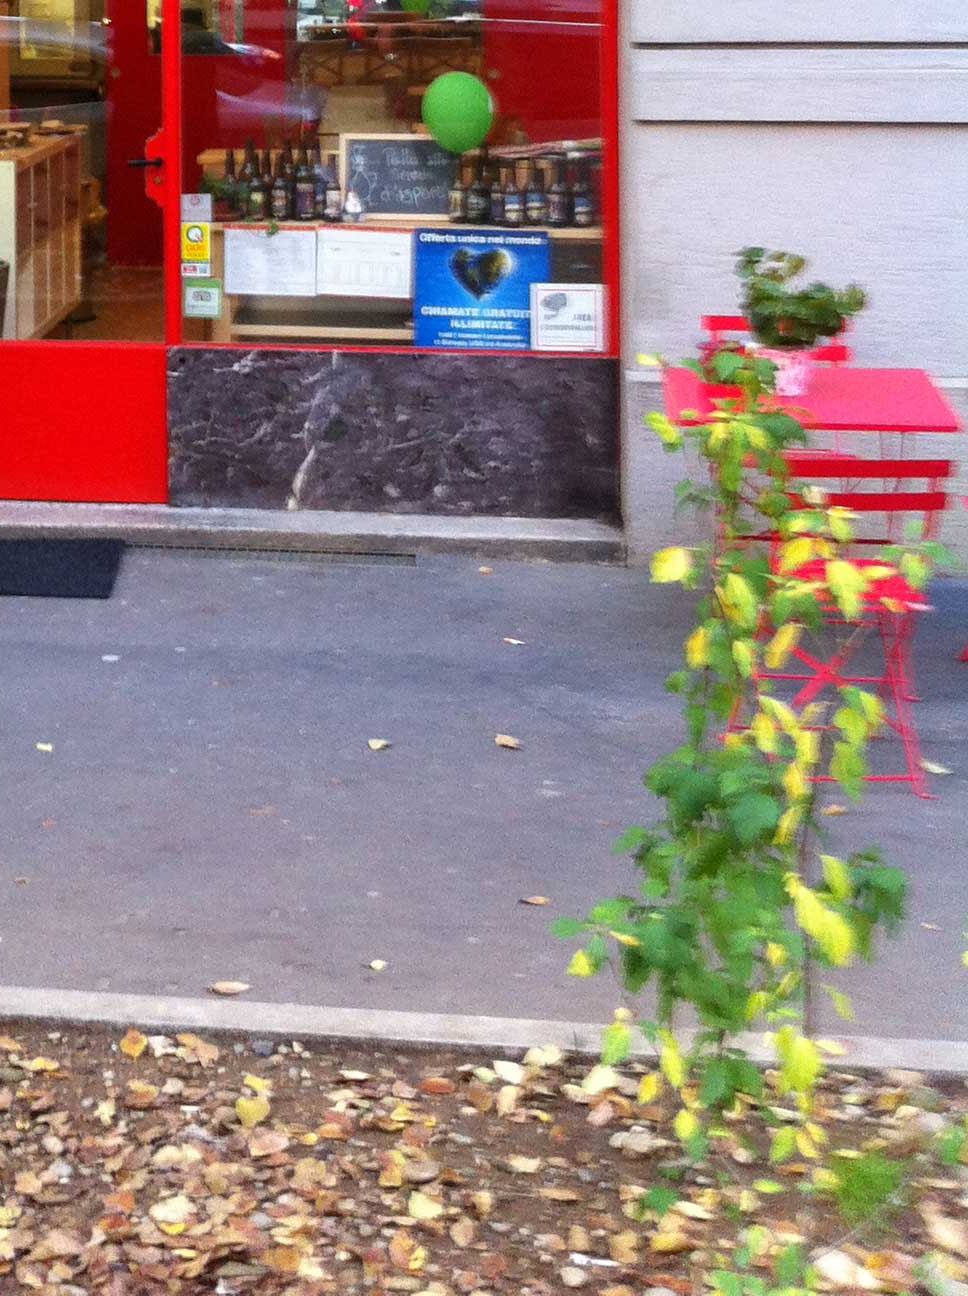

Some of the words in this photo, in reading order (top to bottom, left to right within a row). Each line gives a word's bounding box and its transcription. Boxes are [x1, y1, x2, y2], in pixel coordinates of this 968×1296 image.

[419, 232, 456, 243] Offerta
[458, 233, 486, 244] unica
[420, 305, 479, 317] CHIAMATE
[482, 308, 531, 318] GRATUIT
